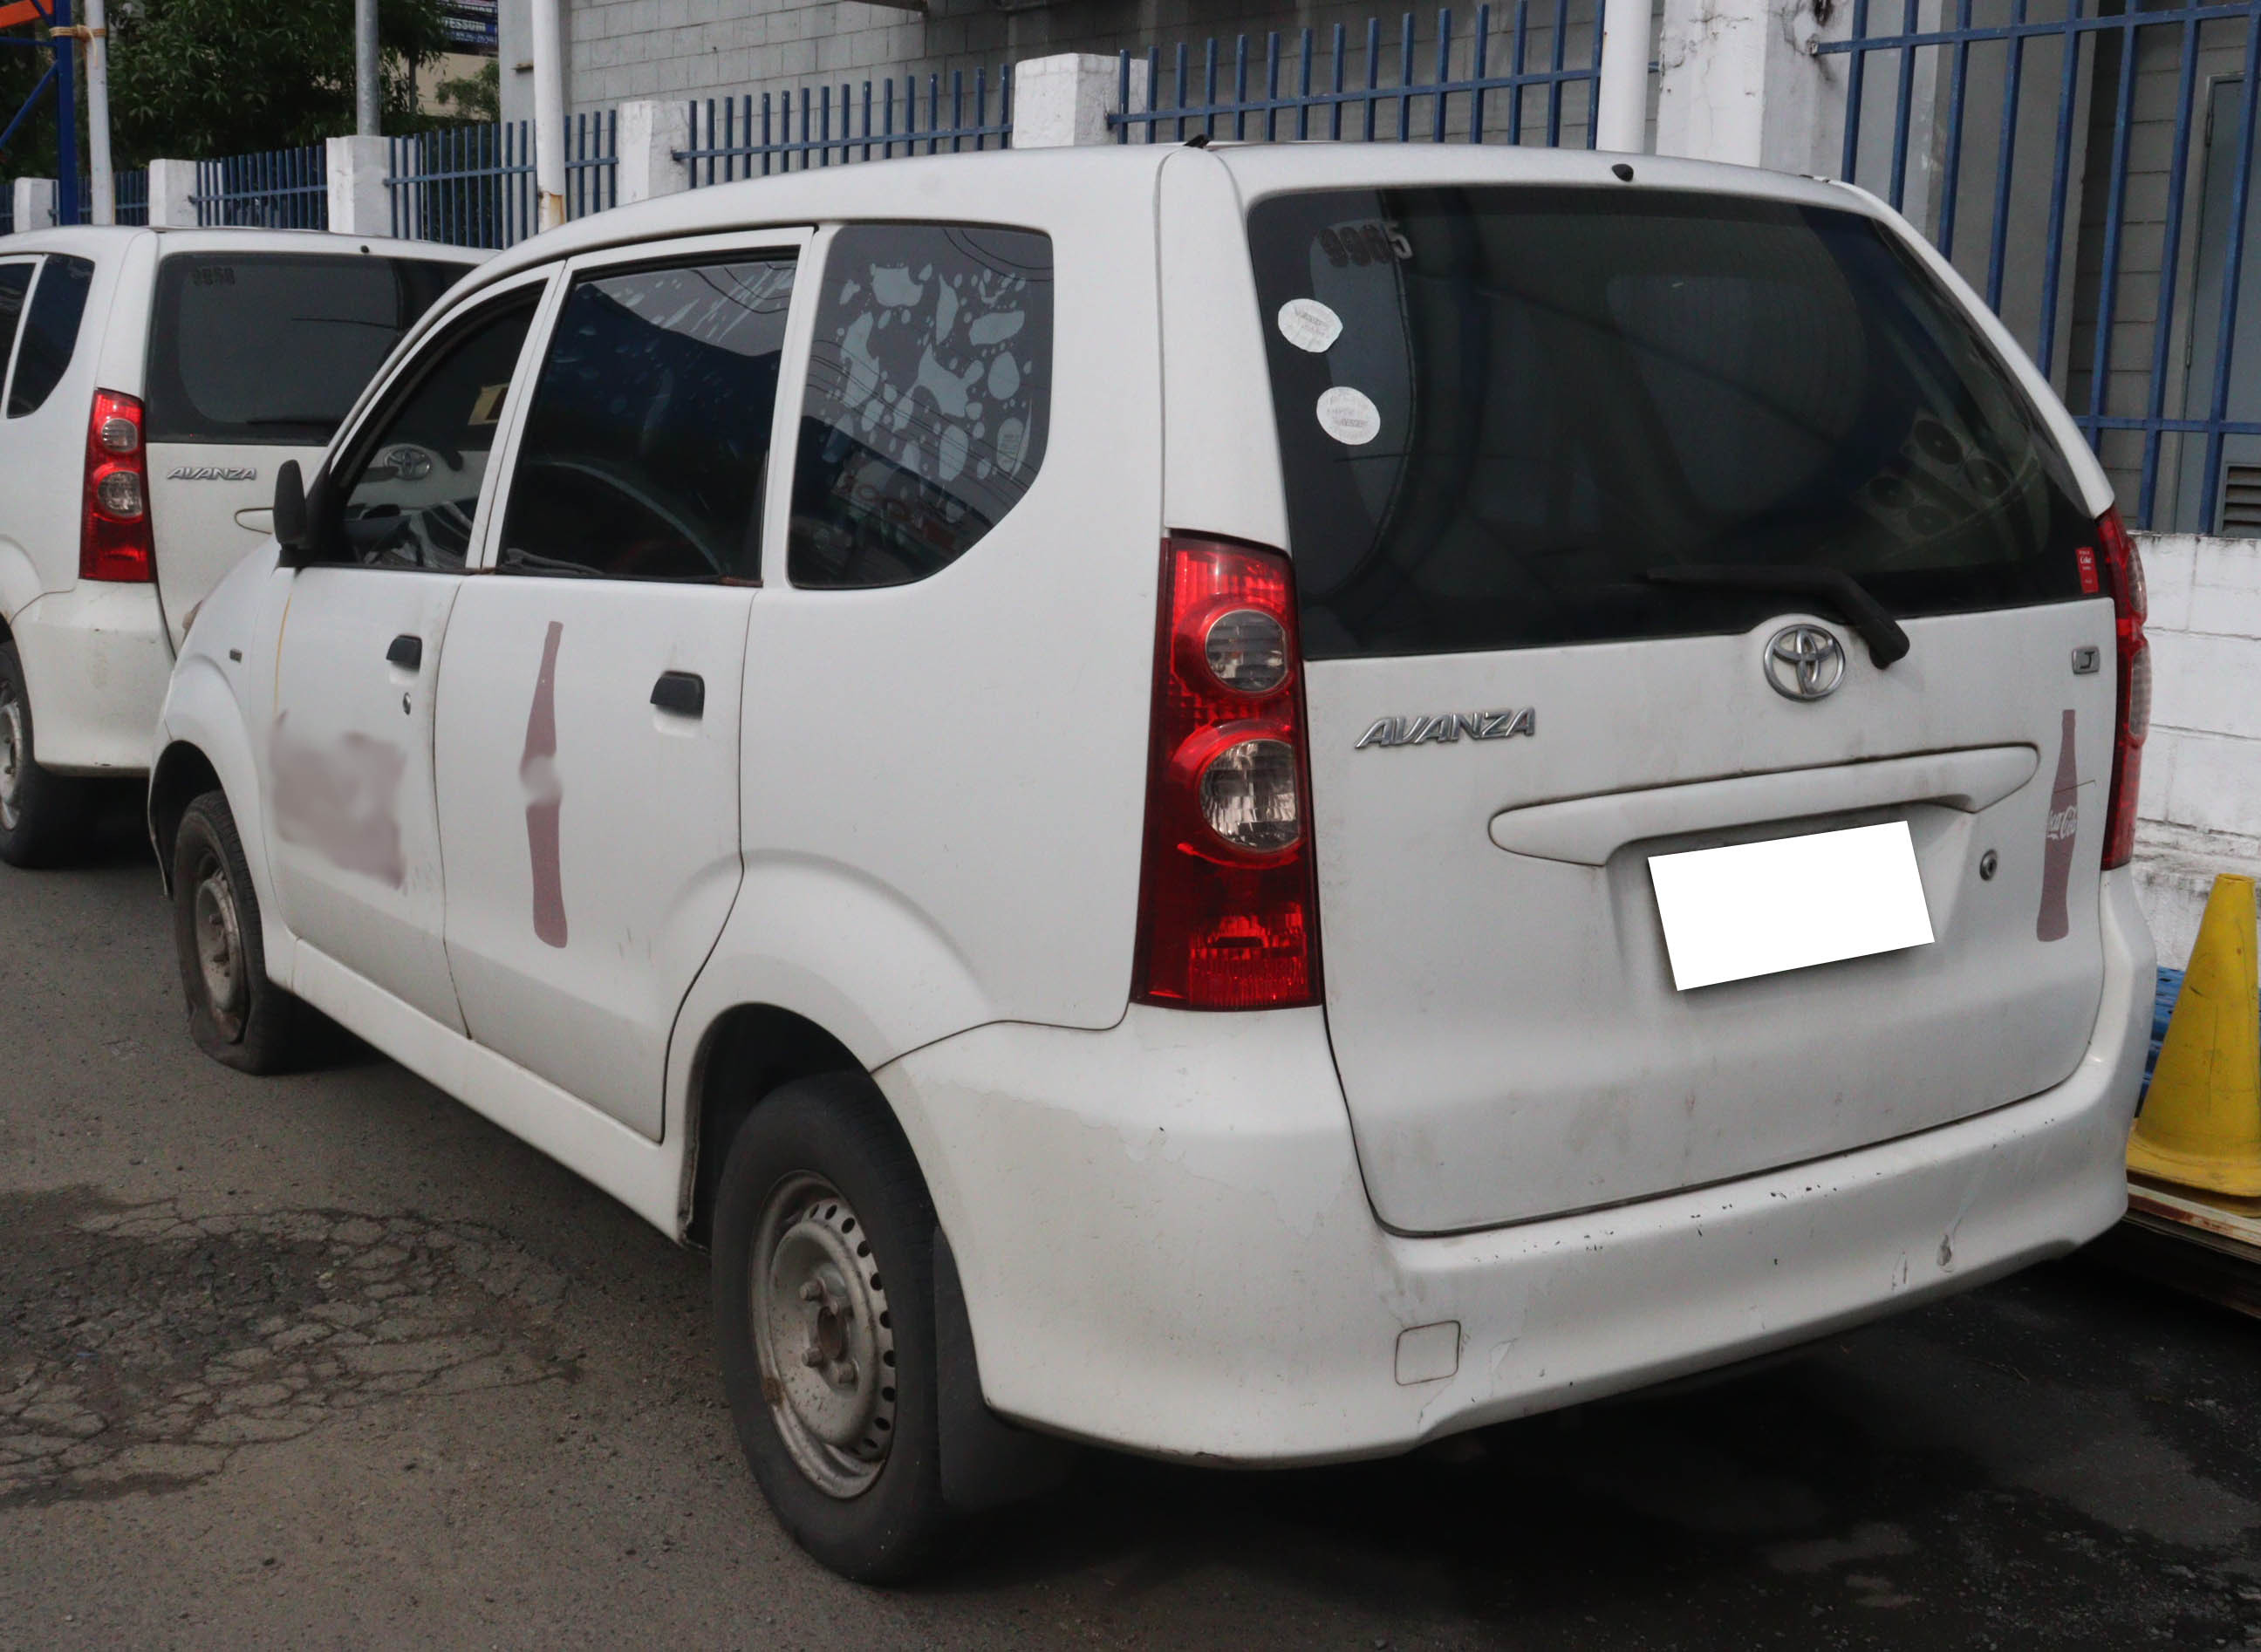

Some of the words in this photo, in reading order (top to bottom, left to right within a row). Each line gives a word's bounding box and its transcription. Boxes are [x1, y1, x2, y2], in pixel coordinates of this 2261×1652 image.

[167, 466, 257, 481] AVANZA
[2080, 651, 2095, 669] J
[1354, 705, 1536, 748] AVANZA
